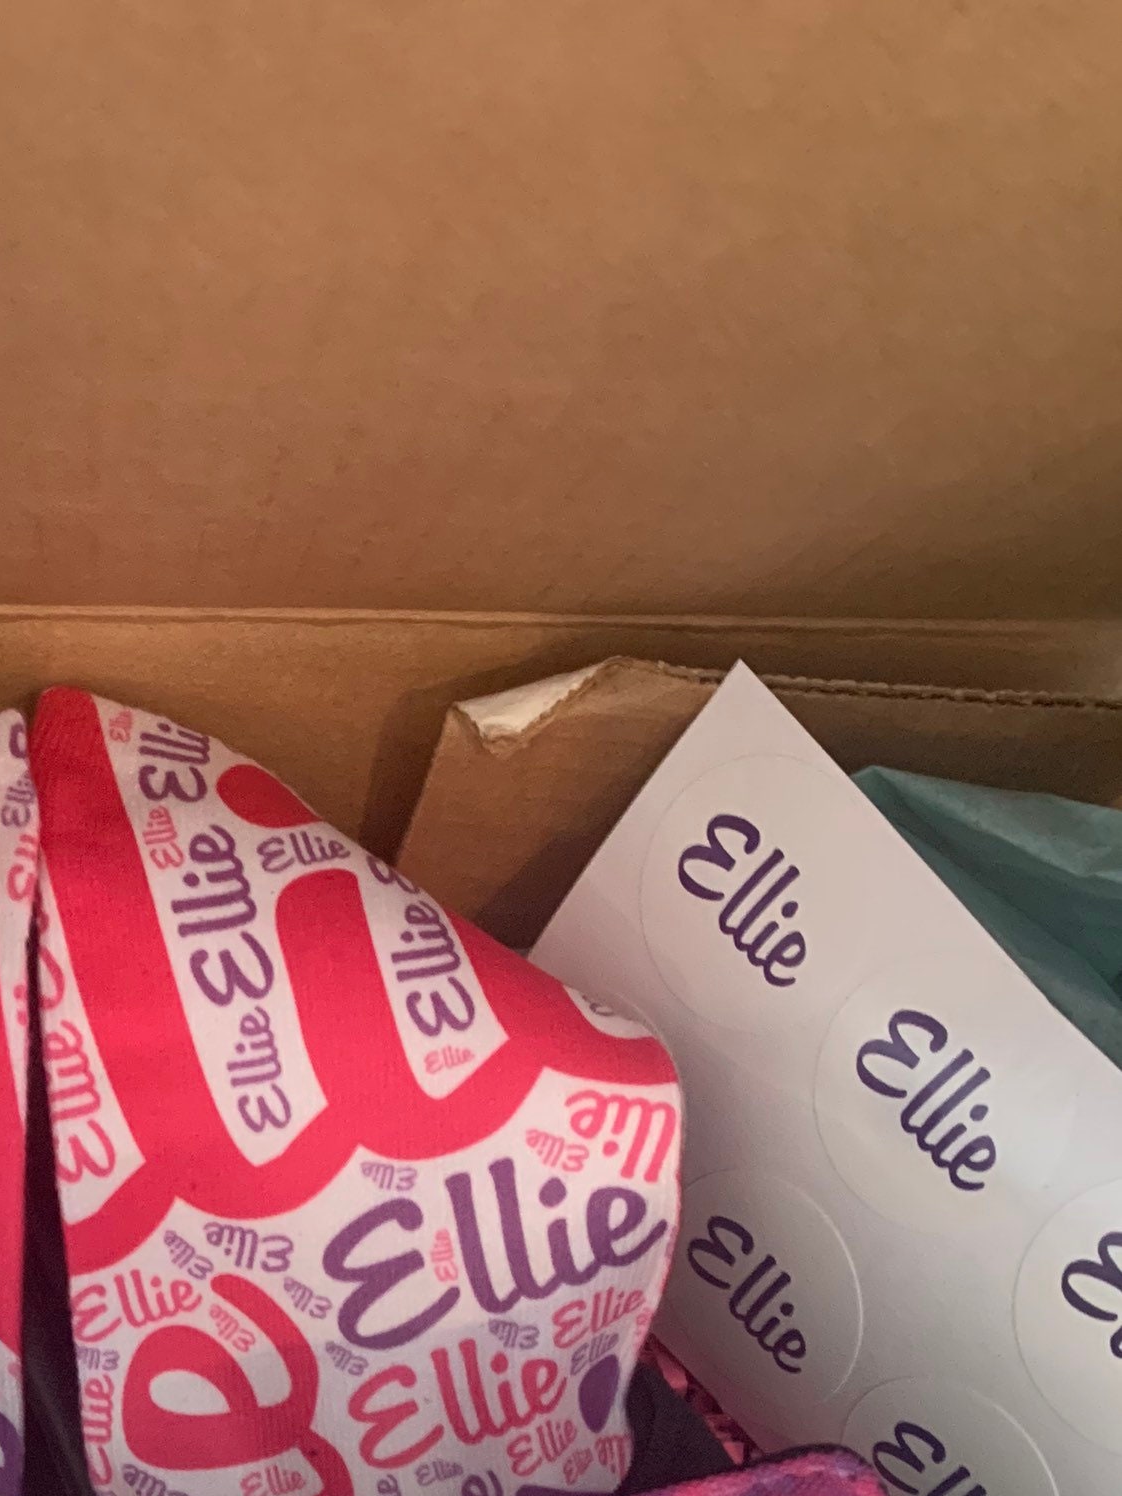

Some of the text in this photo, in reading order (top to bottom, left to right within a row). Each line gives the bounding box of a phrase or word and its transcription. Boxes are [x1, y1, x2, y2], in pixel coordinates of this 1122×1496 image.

[142, 805, 185, 870] Ellie
[256, 831, 351, 873] Ellie
[171, 824, 274, 1007] Ellie
[677, 813, 809, 988] Ellie
[391, 900, 476, 1037] Ellie
[227, 1005, 292, 1134] Ellie
[424, 1045, 475, 1075] Ellie
[856, 1008, 998, 1192] Ellie
[526, 1128, 590, 1173] Ellie
[163, 1229, 214, 1280] Ellie
[203, 1221, 294, 1273] Ellie
[321, 1157, 668, 1351] Ellie
[72, 1269, 202, 1342] Ellie
[283, 1276, 332, 1320] Ellie
[552, 1287, 646, 1349] Ellie
[687, 1215, 809, 1375] Ellie
[208, 1303, 257, 1353] Ellie
[348, 1338, 567, 1469] Ellie
[507, 1419, 577, 1477] Ellie
